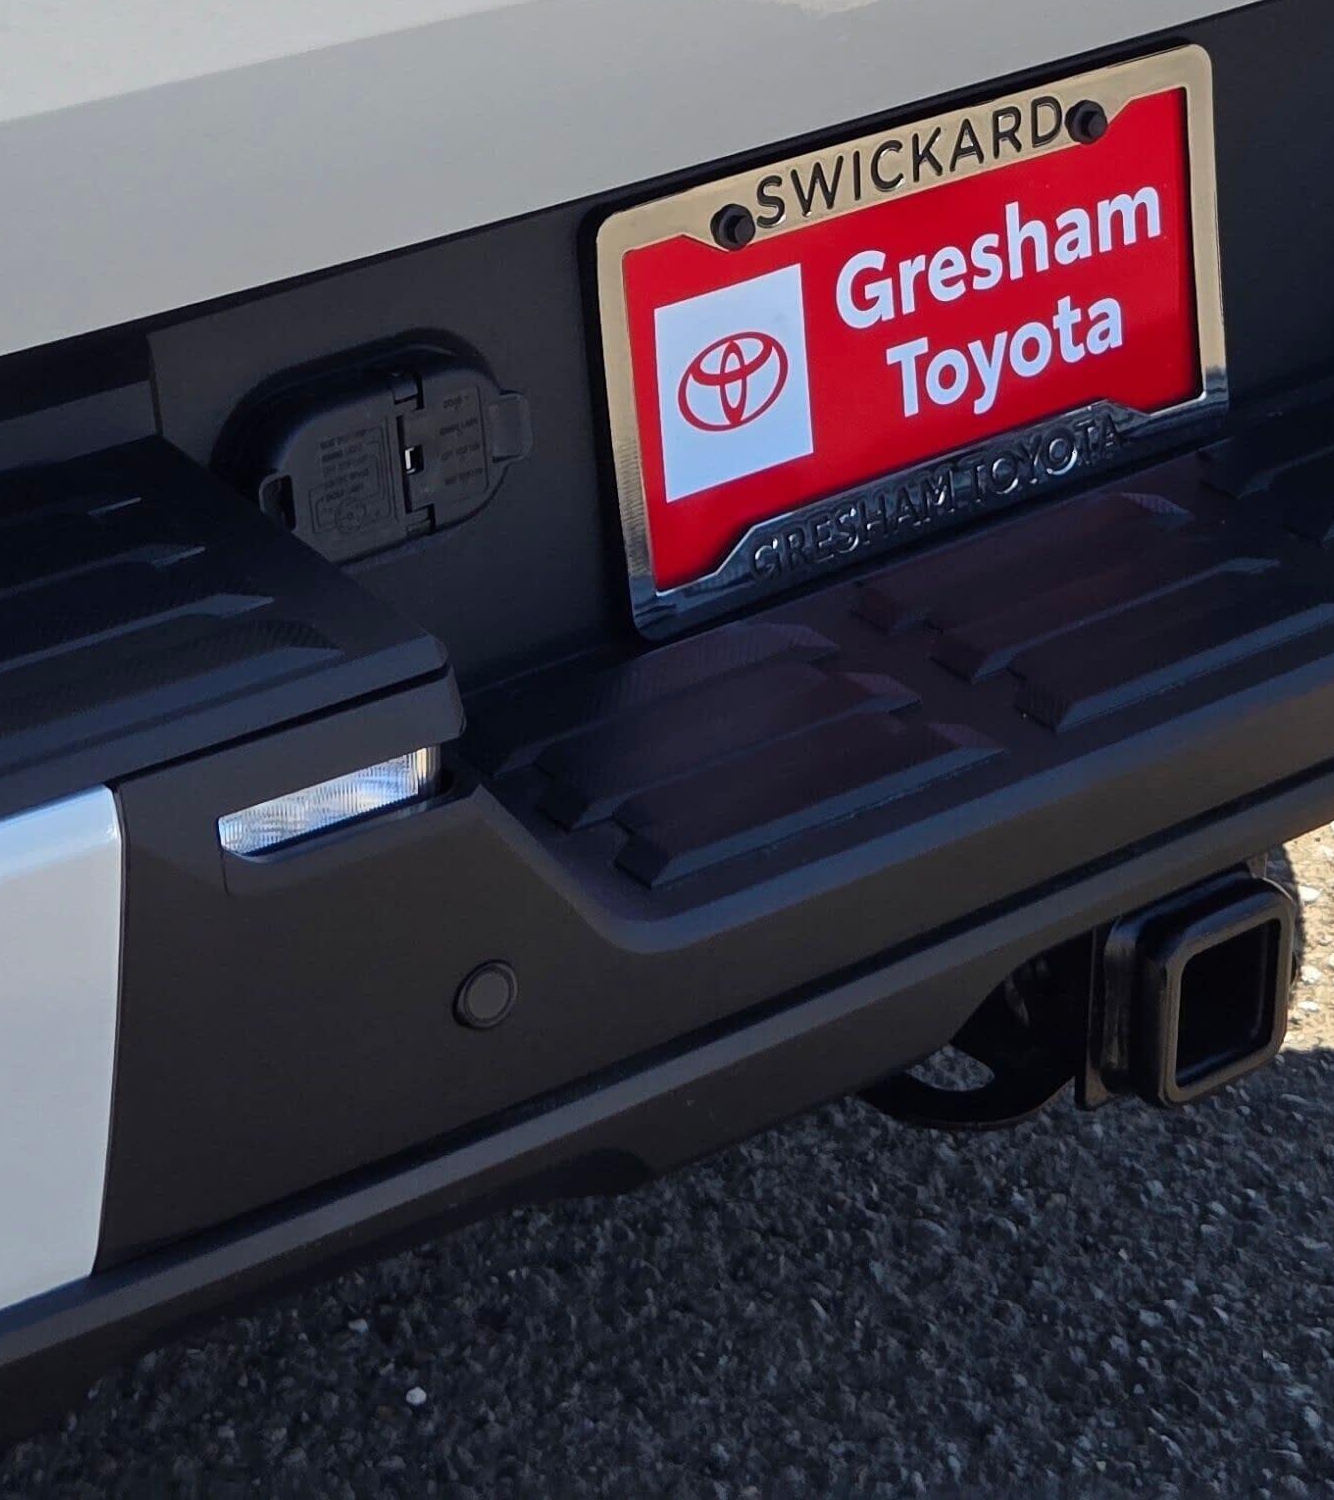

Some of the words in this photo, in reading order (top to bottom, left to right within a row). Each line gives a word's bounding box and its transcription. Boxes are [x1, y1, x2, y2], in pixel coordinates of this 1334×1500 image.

[755, 95, 1064, 229] SWICKARD
[834, 185, 1161, 329] Gresham
[885, 295, 1123, 417] Toyota
[752, 463, 955, 580] GRESHAM
[967, 412, 1126, 501] TOYOTA
